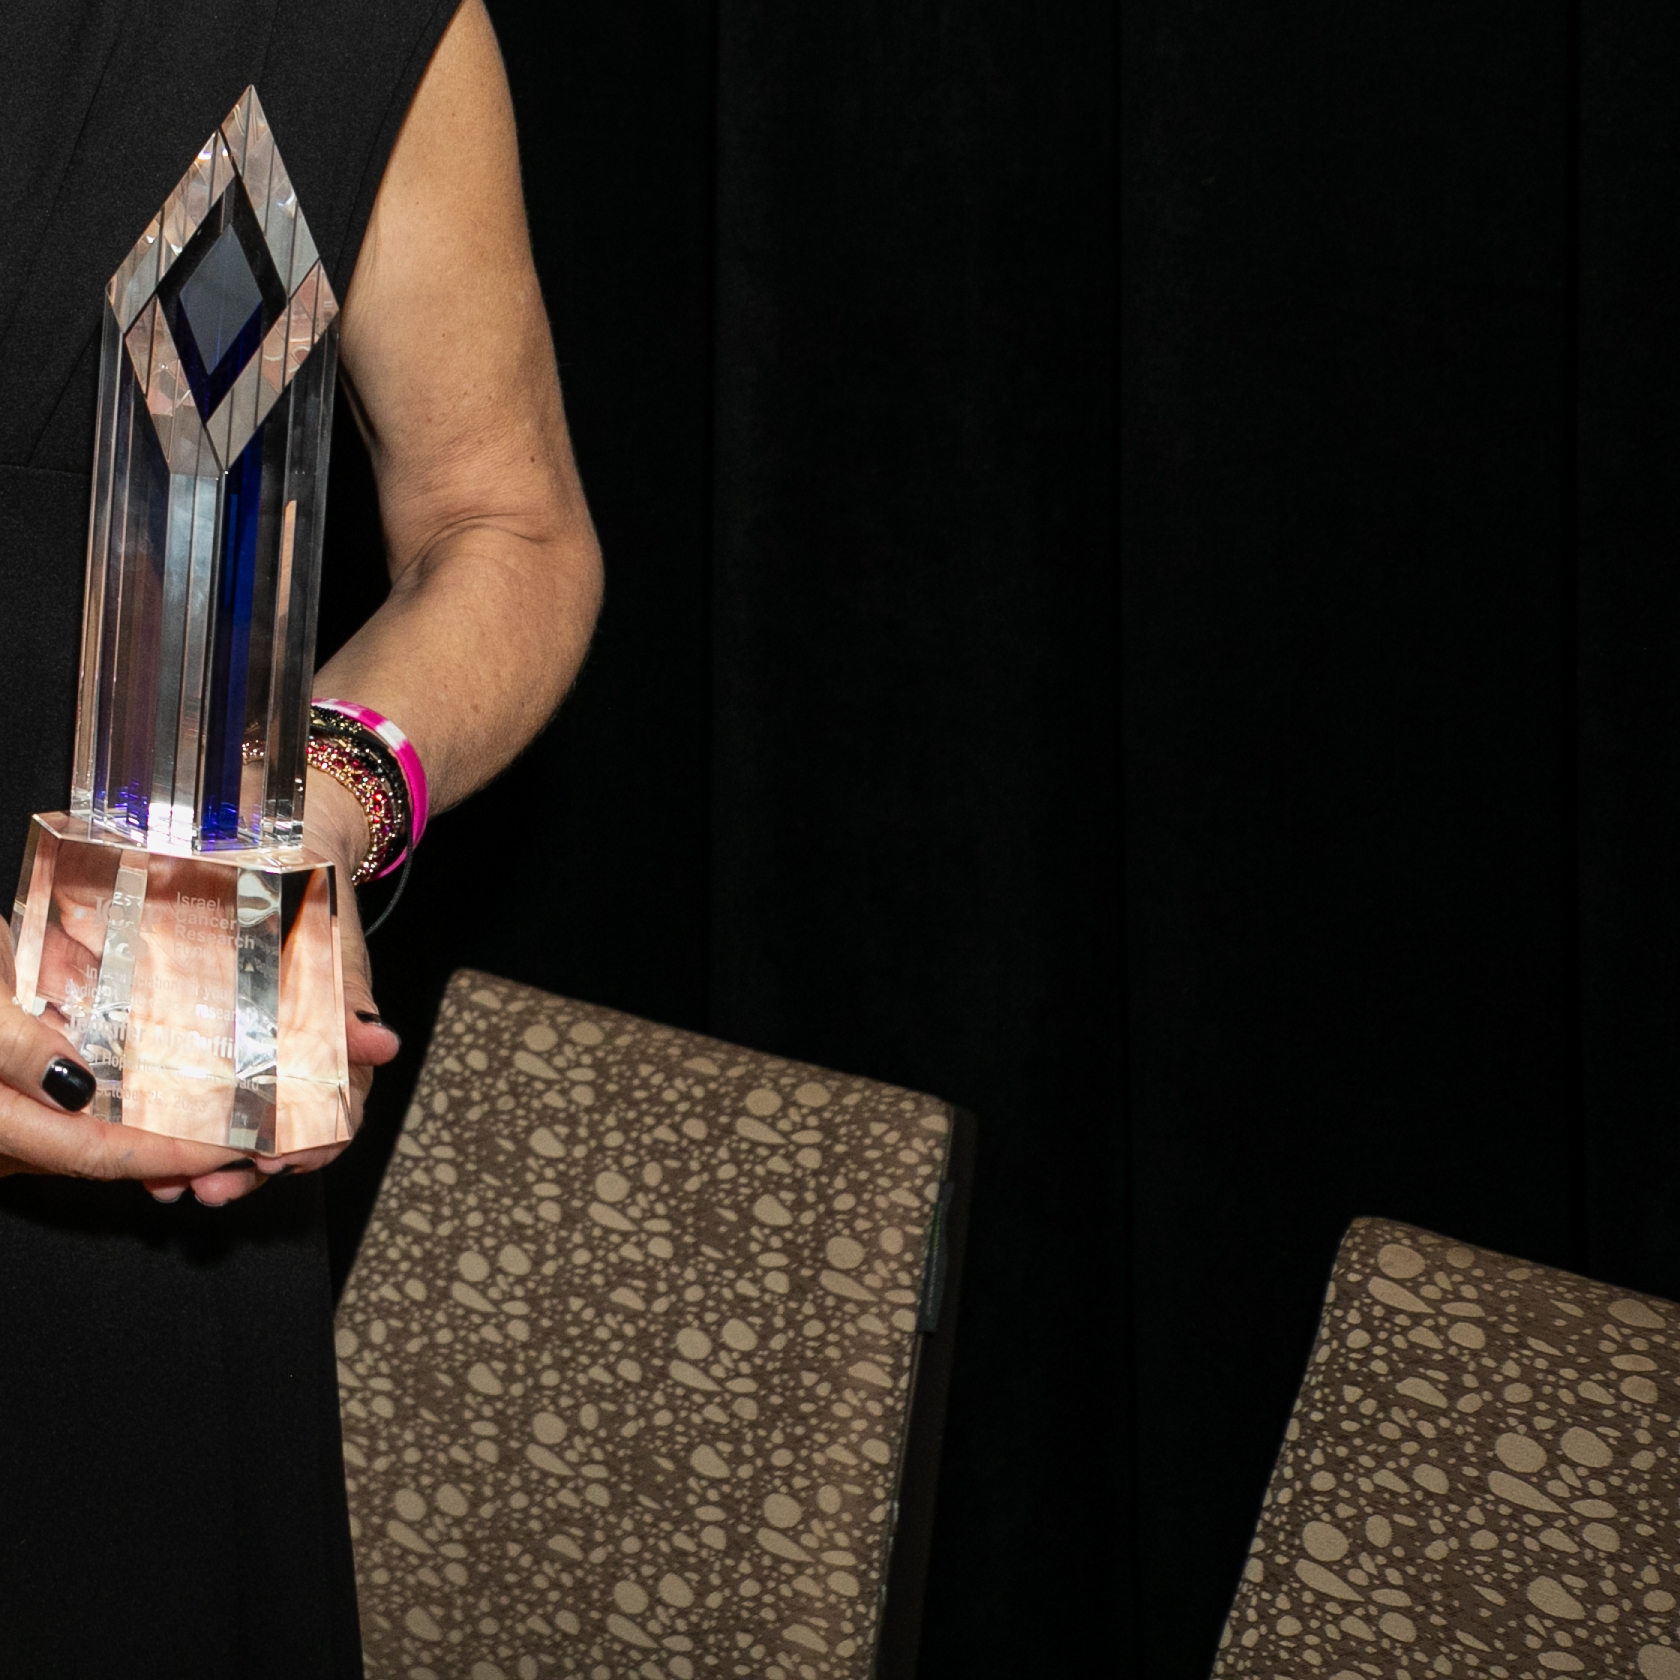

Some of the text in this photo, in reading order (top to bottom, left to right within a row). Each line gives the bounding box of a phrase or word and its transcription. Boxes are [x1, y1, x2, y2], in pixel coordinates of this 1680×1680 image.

[176, 891, 221, 912] Israel
[175, 908, 237, 931] Cancer
[173, 925, 256, 950] Research
